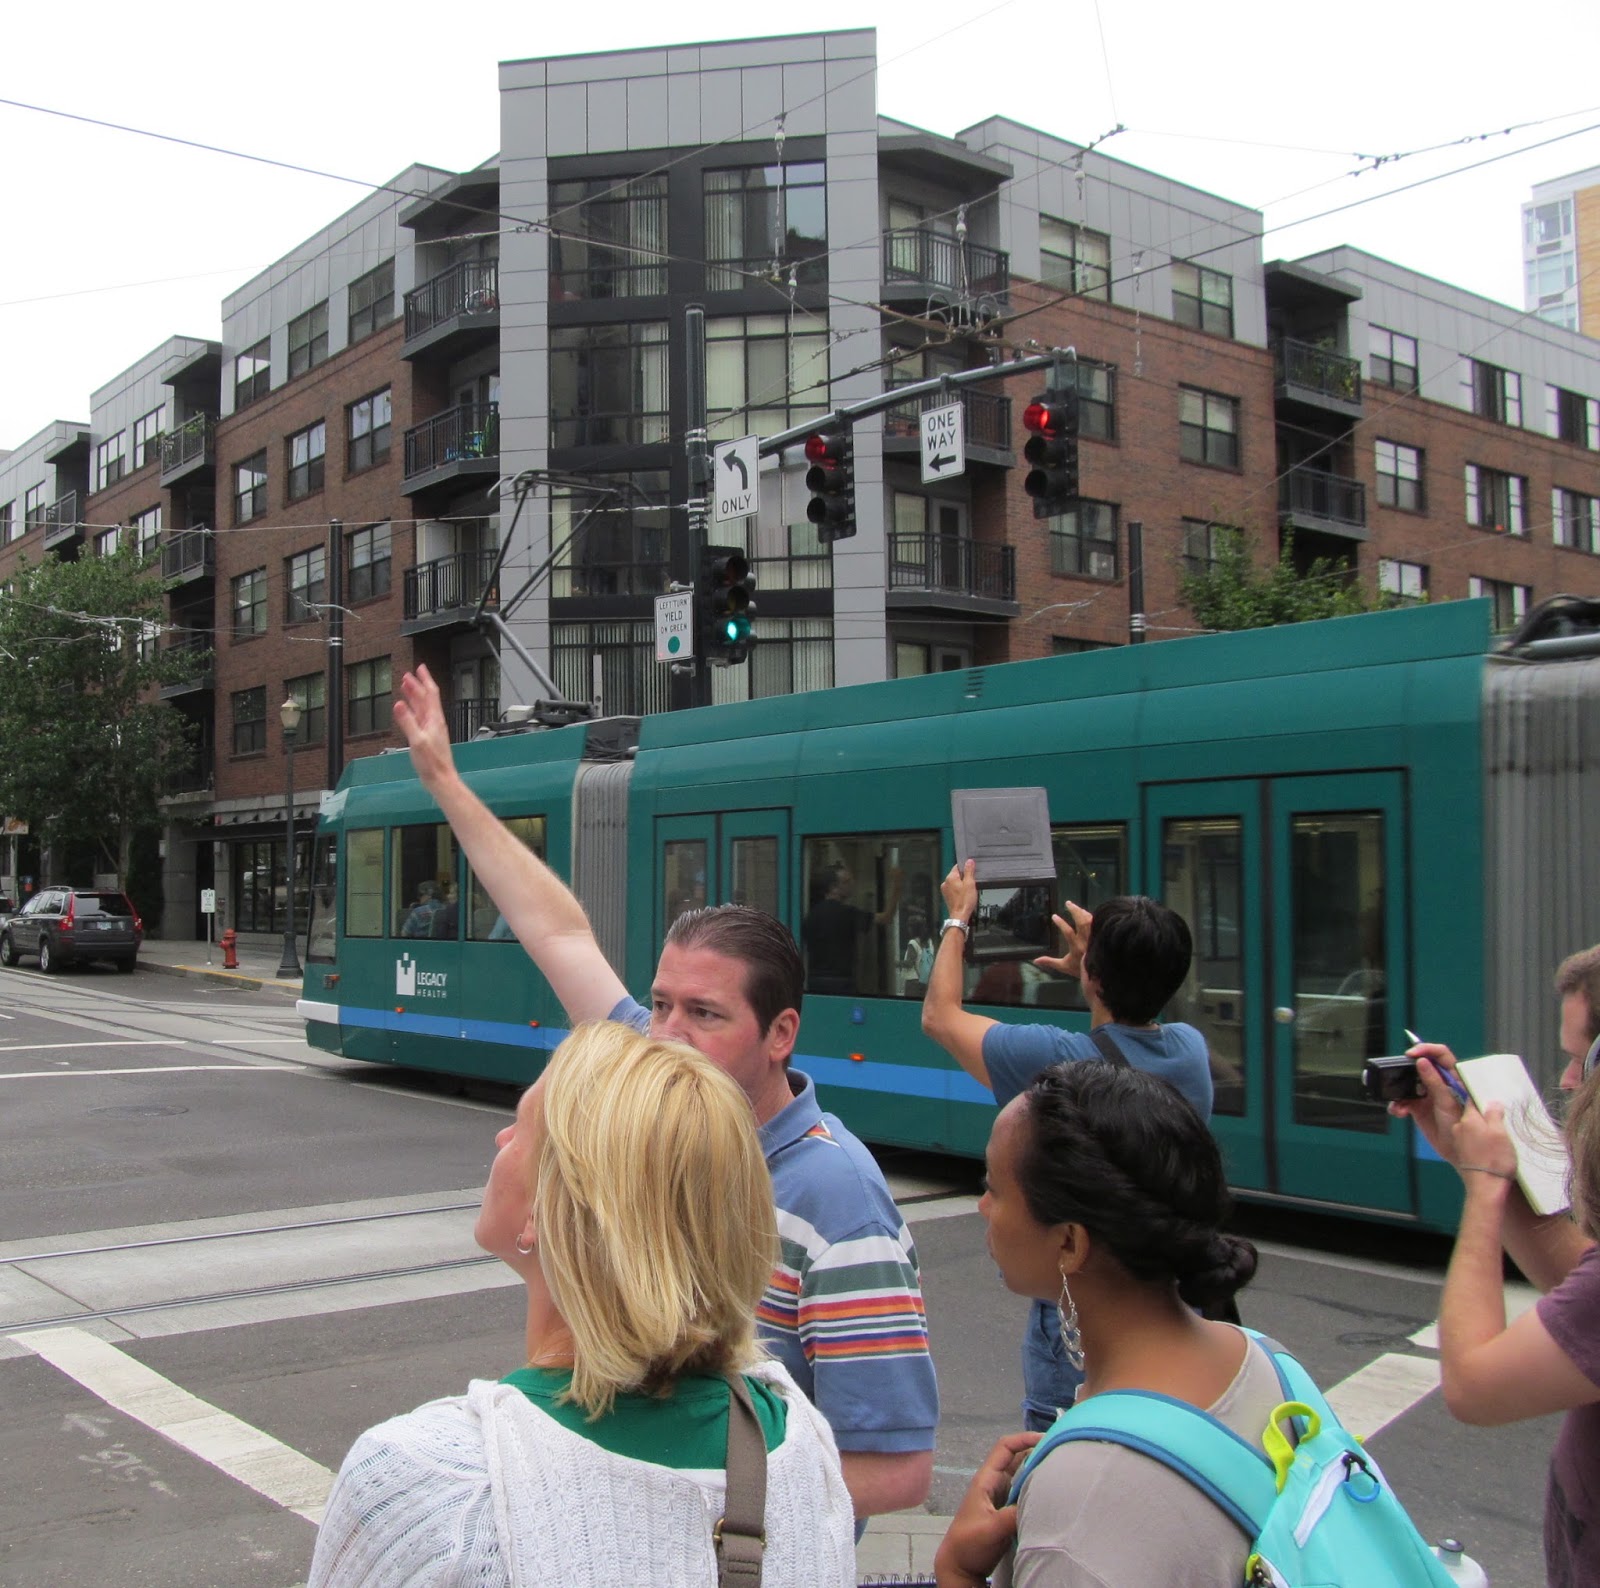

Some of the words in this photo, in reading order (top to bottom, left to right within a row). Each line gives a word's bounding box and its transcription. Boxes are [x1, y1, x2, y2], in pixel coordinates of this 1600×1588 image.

[928, 411, 955, 431] ONE
[928, 429, 956, 450] WAY
[722, 493, 751, 514] ONLY
[660, 601, 672, 610] LEFT
[673, 599, 687, 608] TURN
[665, 610, 682, 622] YIELD
[661, 626, 668, 634] ON
[670, 623, 687, 633] GREEN
[417, 972, 447, 986] LEGACY
[417, 989, 447, 998] HEALTH
